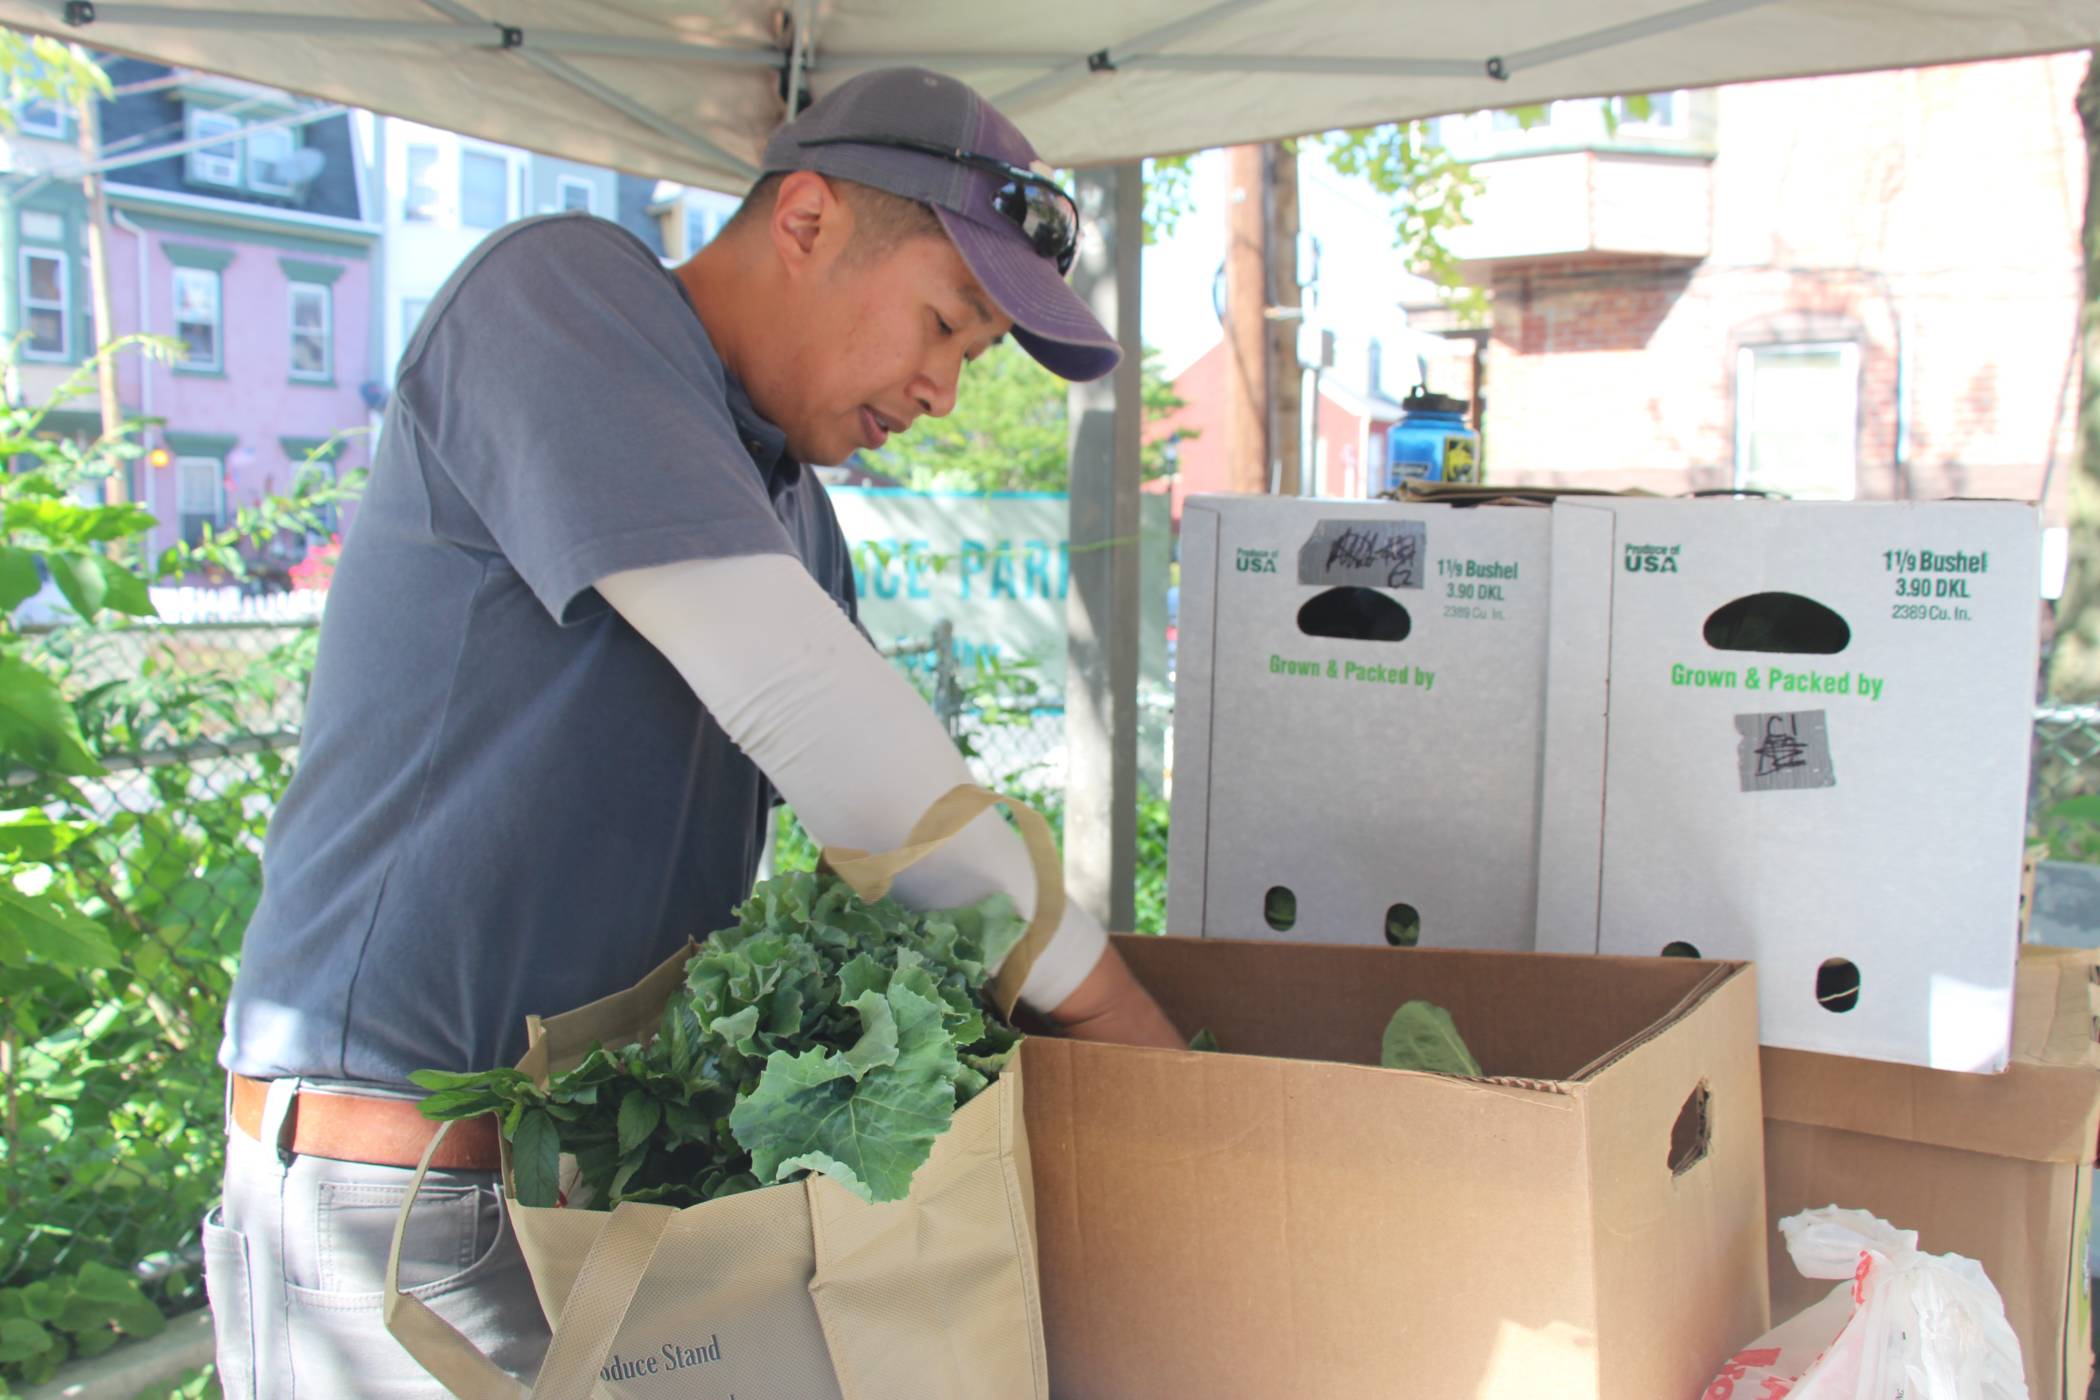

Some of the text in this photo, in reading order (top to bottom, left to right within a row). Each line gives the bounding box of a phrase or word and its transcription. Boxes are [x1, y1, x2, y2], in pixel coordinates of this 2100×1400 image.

[1236, 557, 1277, 573] USA
[1465, 559, 1519, 580] Bushel
[1625, 555, 1678, 573] USA
[1920, 549, 1988, 573] Bushel
[1446, 582, 1505, 601] 3.90 DKL
[1896, 577, 1972, 598] 3.90 DKL
[1891, 604, 1973, 621] 2389 Cu. In.
[1269, 654, 1436, 691] Grown & Packed by
[1670, 662, 1884, 701] Grown & Packed by
[600, 1333, 721, 1381] oduce Stand
